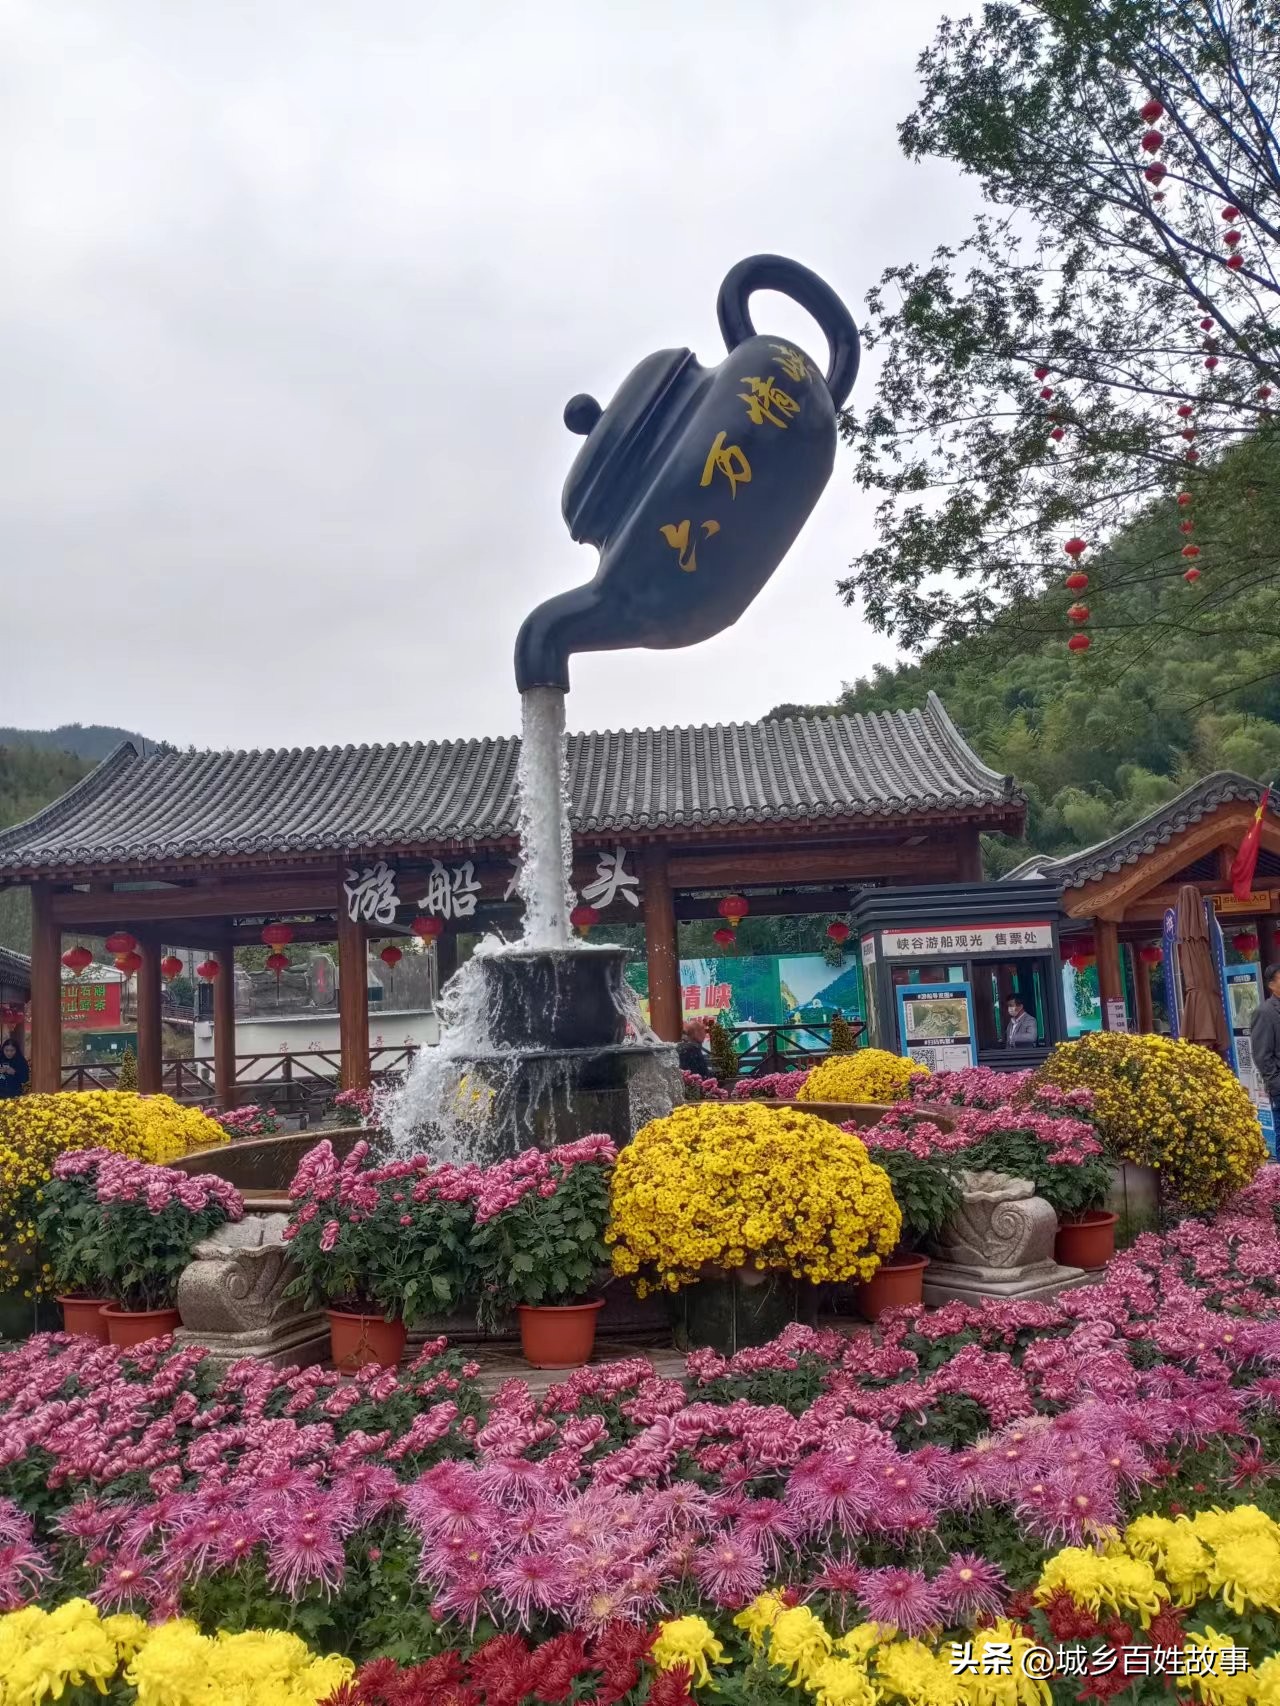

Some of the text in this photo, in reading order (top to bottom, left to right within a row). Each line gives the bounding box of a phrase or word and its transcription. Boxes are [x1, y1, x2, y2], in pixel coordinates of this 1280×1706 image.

[343, 847, 640, 925] 游船头
[897, 932, 1037, 950] 峡谷游船观光 售票处
